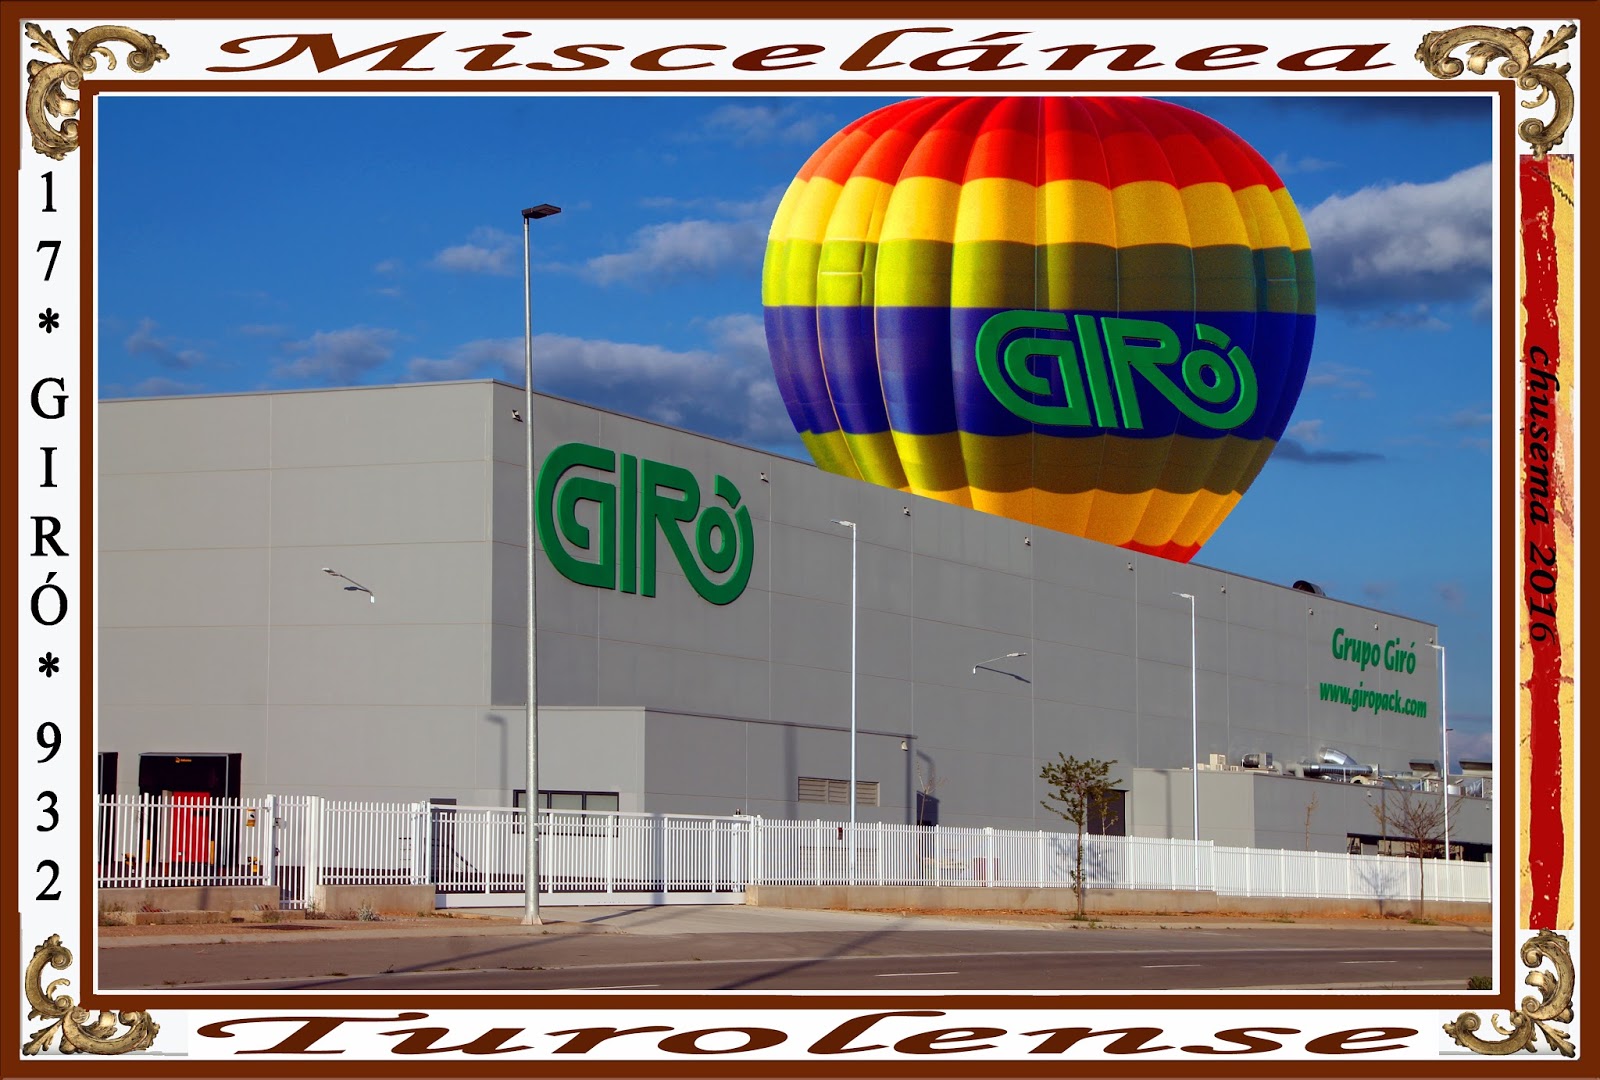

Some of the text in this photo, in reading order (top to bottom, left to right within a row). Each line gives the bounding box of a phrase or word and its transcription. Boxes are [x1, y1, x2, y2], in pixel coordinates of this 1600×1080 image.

[1332, 627, 1417, 674] Grupo Giró
[1319, 681, 1428, 718] www.giropack.com
